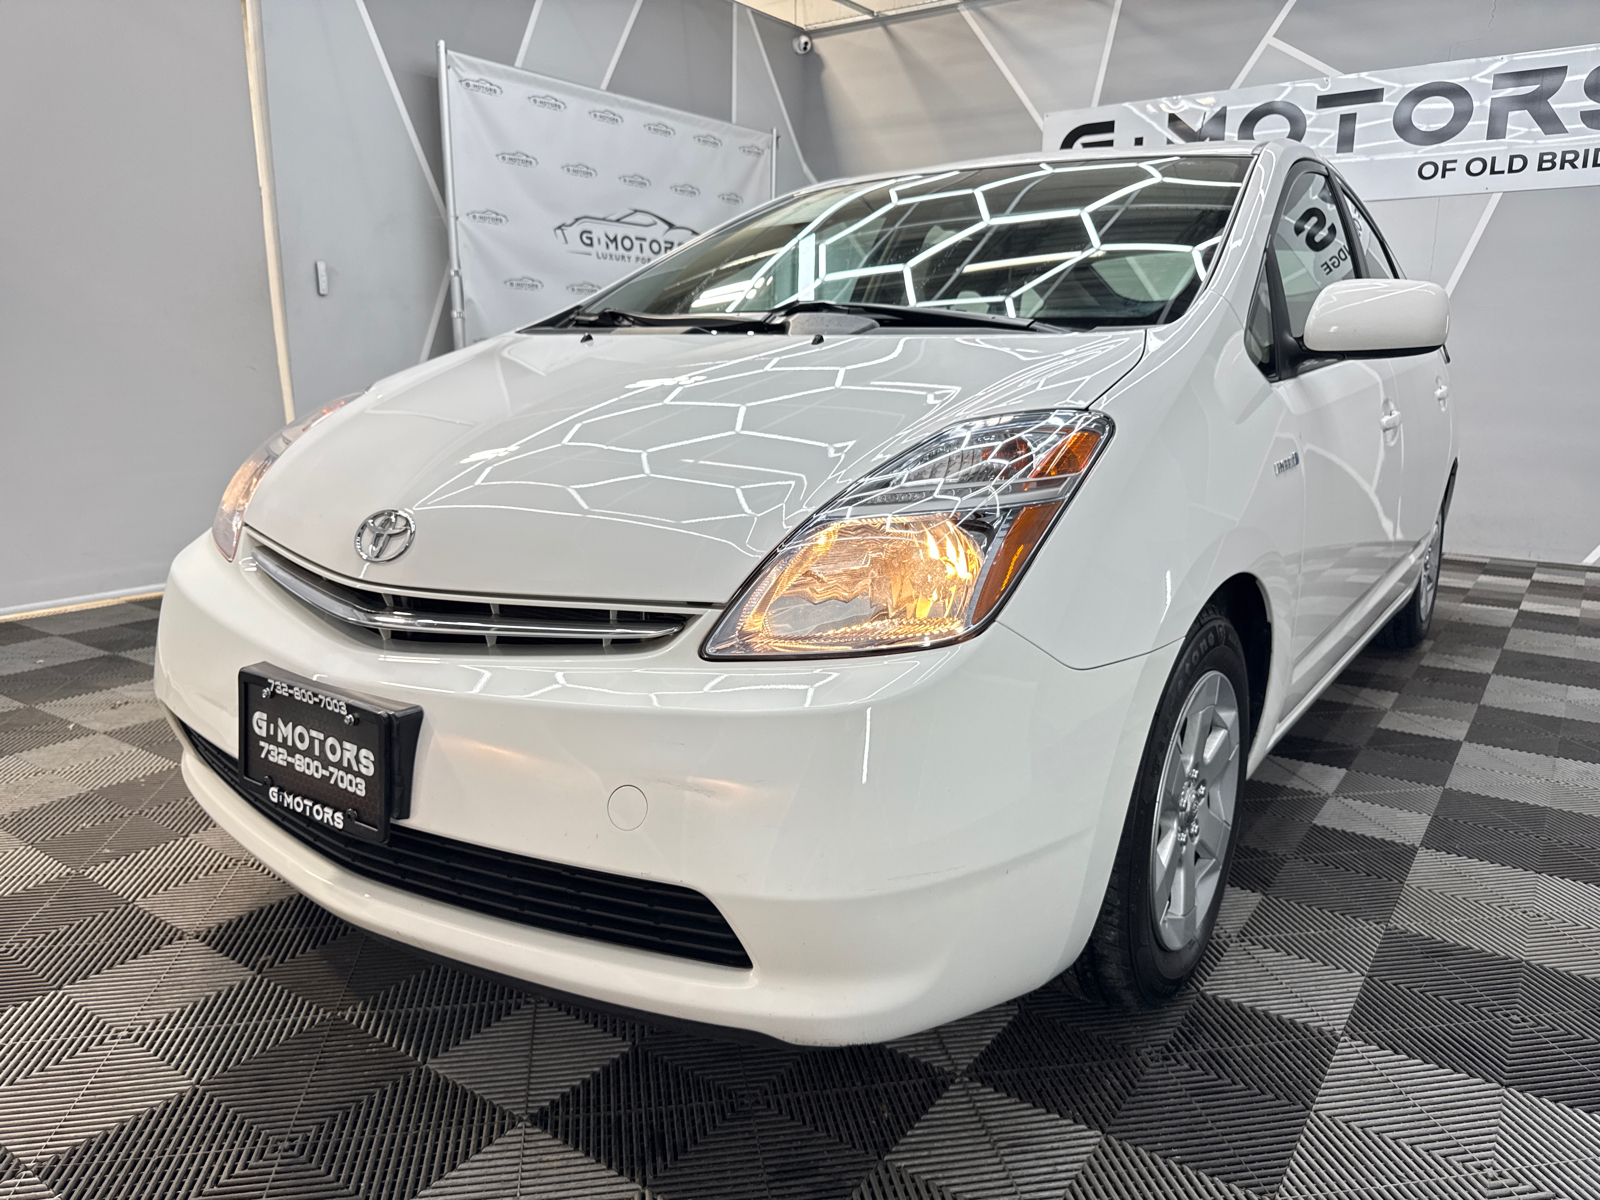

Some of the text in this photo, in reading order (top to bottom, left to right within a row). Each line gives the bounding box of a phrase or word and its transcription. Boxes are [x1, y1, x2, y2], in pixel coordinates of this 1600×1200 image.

[1417, 159, 1458, 181] OF
[1465, 154, 1529, 177] OLD
[596, 252, 632, 263] LUXURY
[267, 678, 348, 715] 732-800-7003
[277, 717, 375, 777] MOTORS
[259, 741, 367, 797] 732-800-7003
[283, 791, 344, 829] MOTORS
